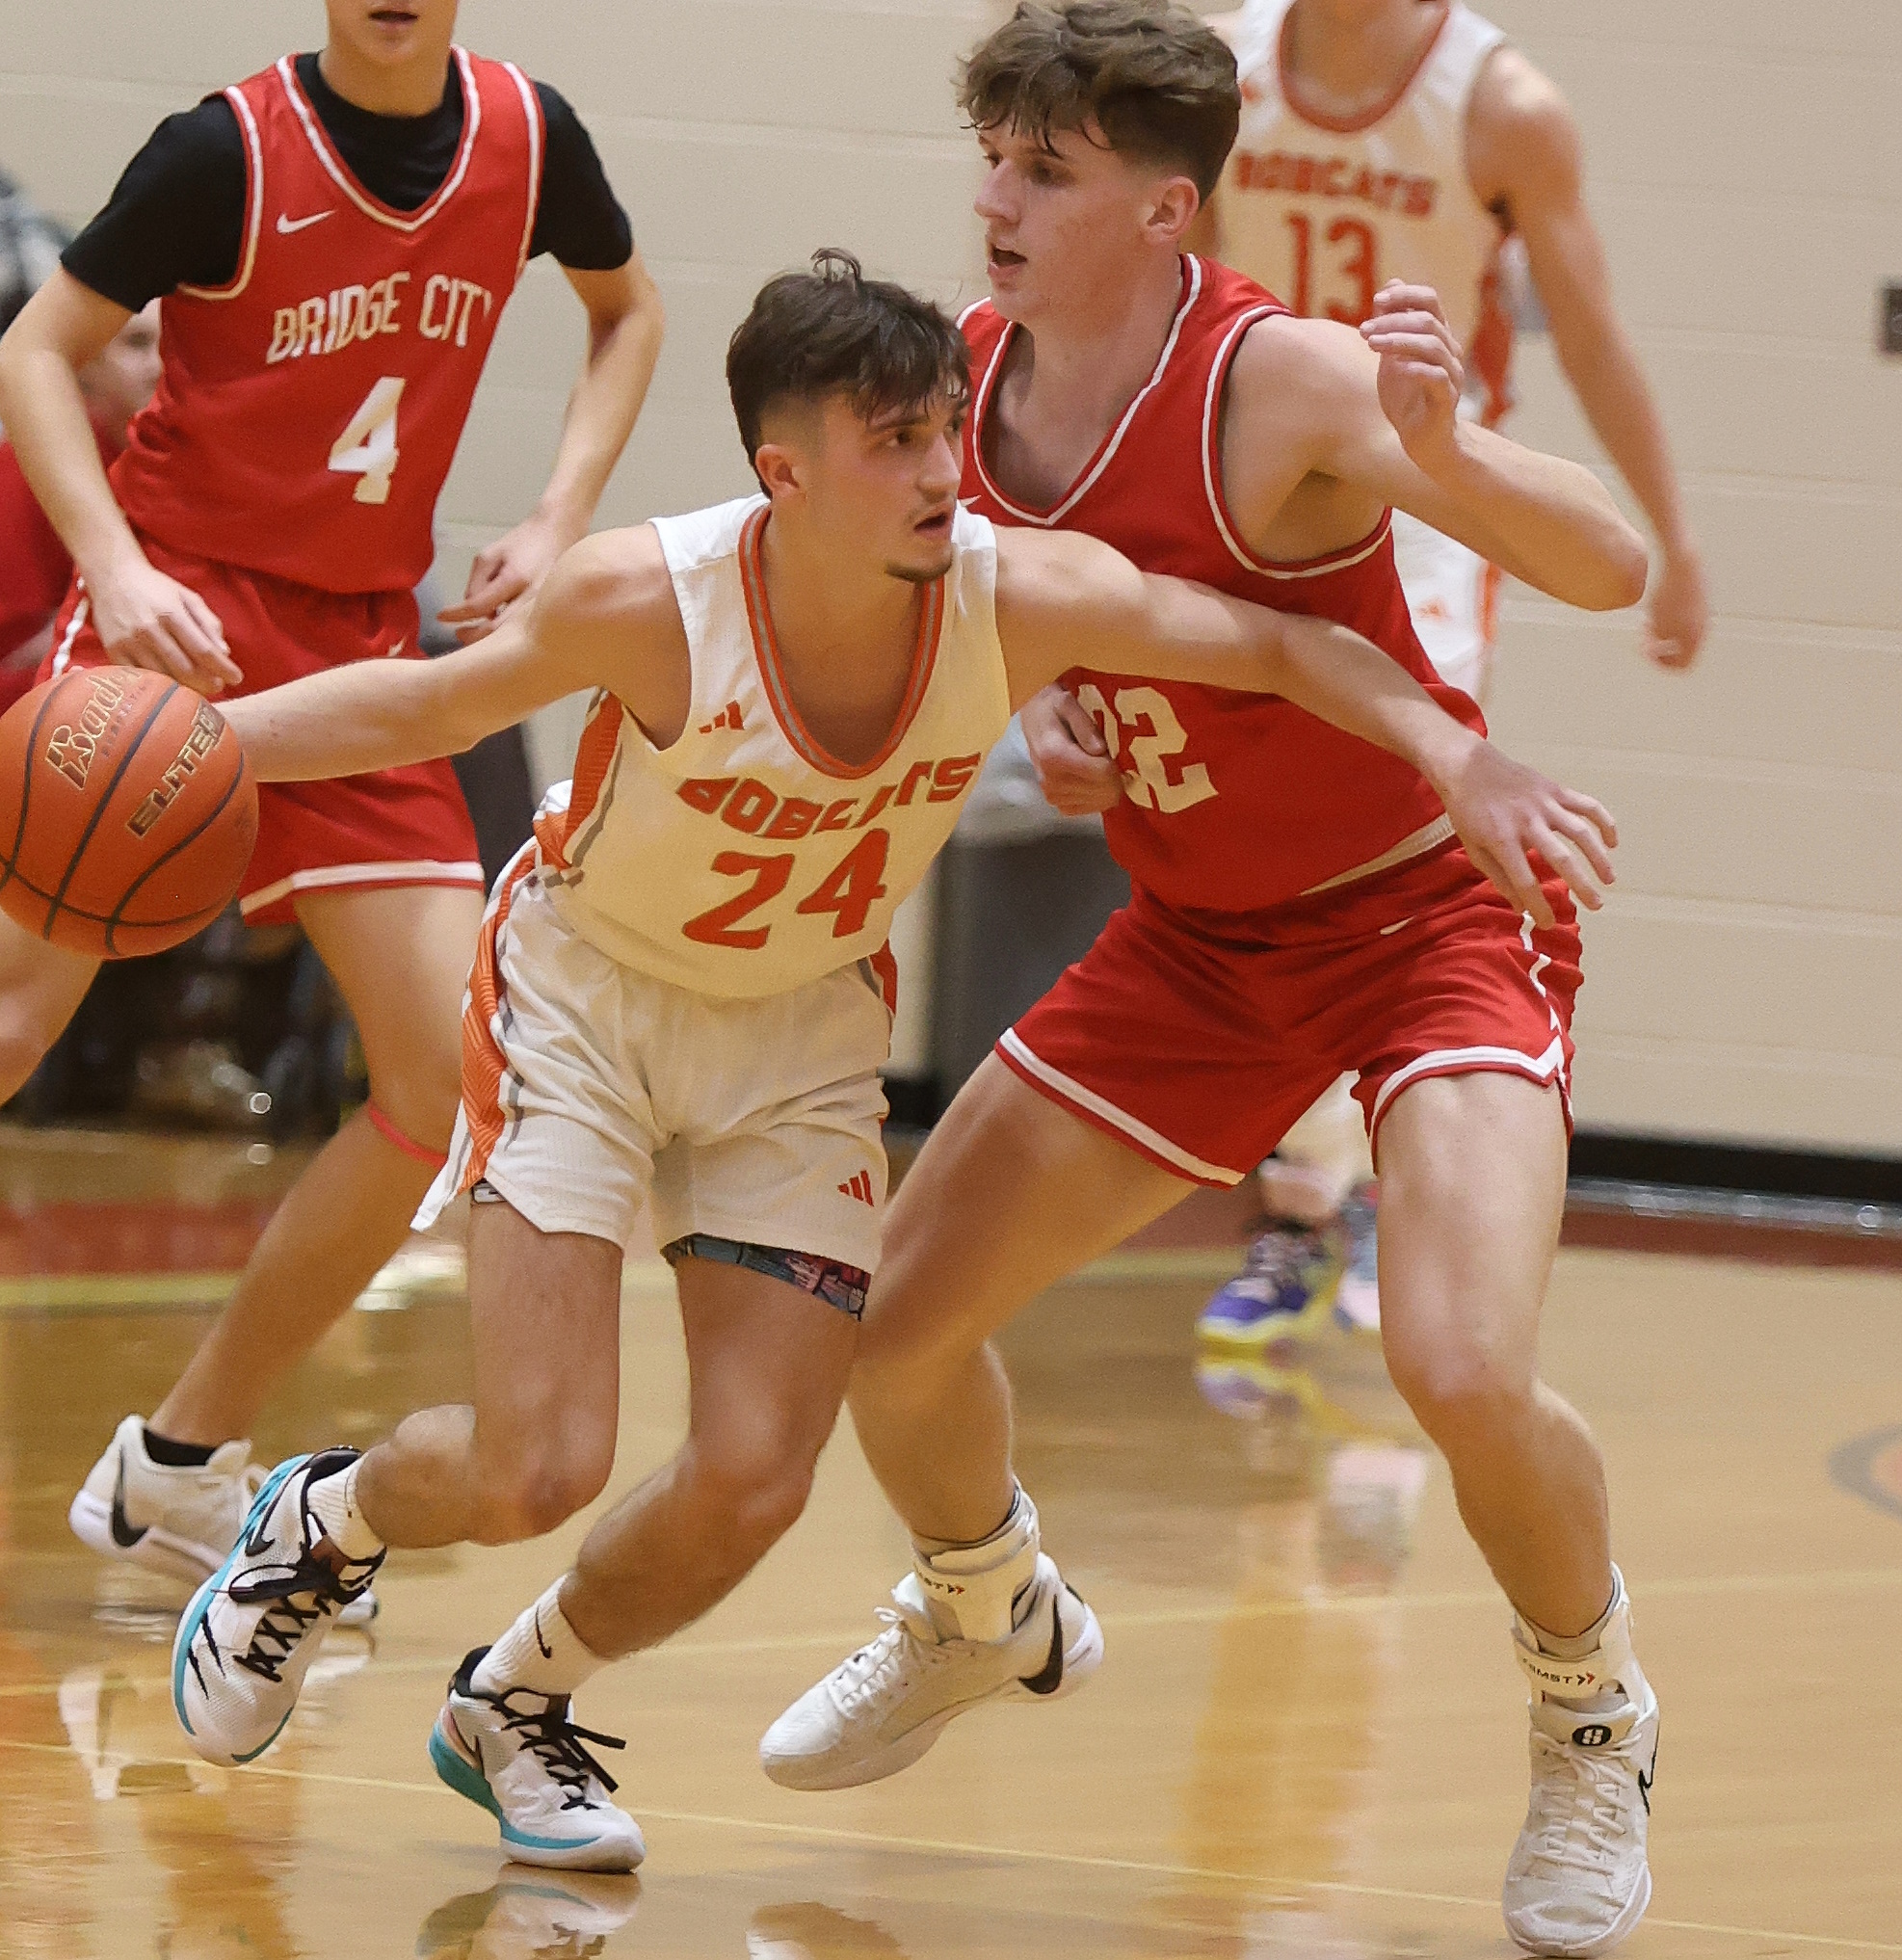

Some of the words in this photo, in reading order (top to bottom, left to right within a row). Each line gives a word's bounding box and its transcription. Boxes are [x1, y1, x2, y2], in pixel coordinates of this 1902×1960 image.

[266, 271, 410, 364] BRIDGE
[1287, 209, 1377, 327] 13
[328, 376, 406, 504] 4
[682, 828, 889, 950] 24
